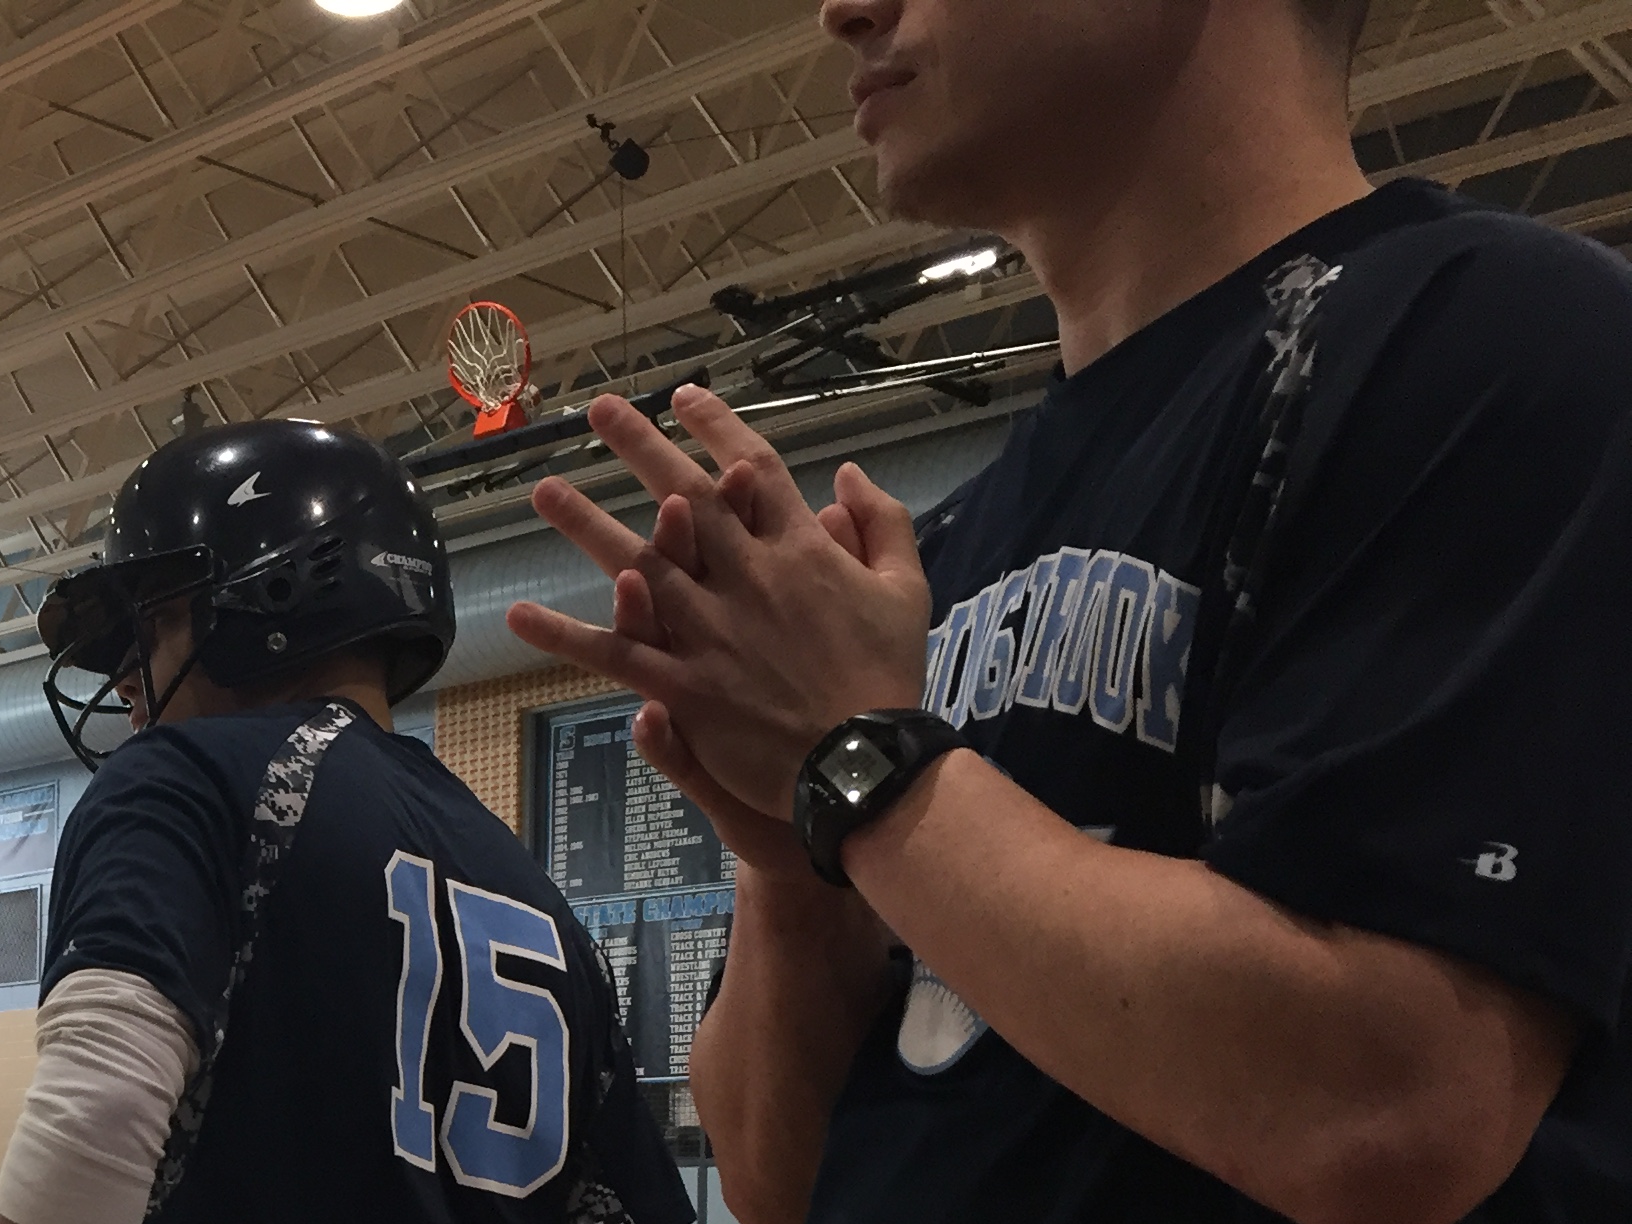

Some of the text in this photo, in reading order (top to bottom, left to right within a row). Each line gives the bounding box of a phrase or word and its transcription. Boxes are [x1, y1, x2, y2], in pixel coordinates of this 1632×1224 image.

[573, 900, 637, 928] STATE
[671, 928, 727, 940] CROSS COUNTRY
[671, 941, 694, 951] TRACK
[705, 938, 726, 948] FIELD
[671, 951, 694, 961] TRACK
[705, 949, 726, 959] FIELD
[671, 960, 710, 971] WRESTLING
[670, 970, 710, 982] WRESTLING
[670, 982, 693, 992] TRACK
[670, 993, 693, 1002] TRACK
[670, 1003, 693, 1012] TRACK
[670, 1013, 693, 1023] TRACK
[384, 849, 569, 1199] 15
[670, 1024, 692, 1033] TRACK
[670, 1034, 692, 1043] TRACK
[669, 1065, 689, 1075] TRAC
